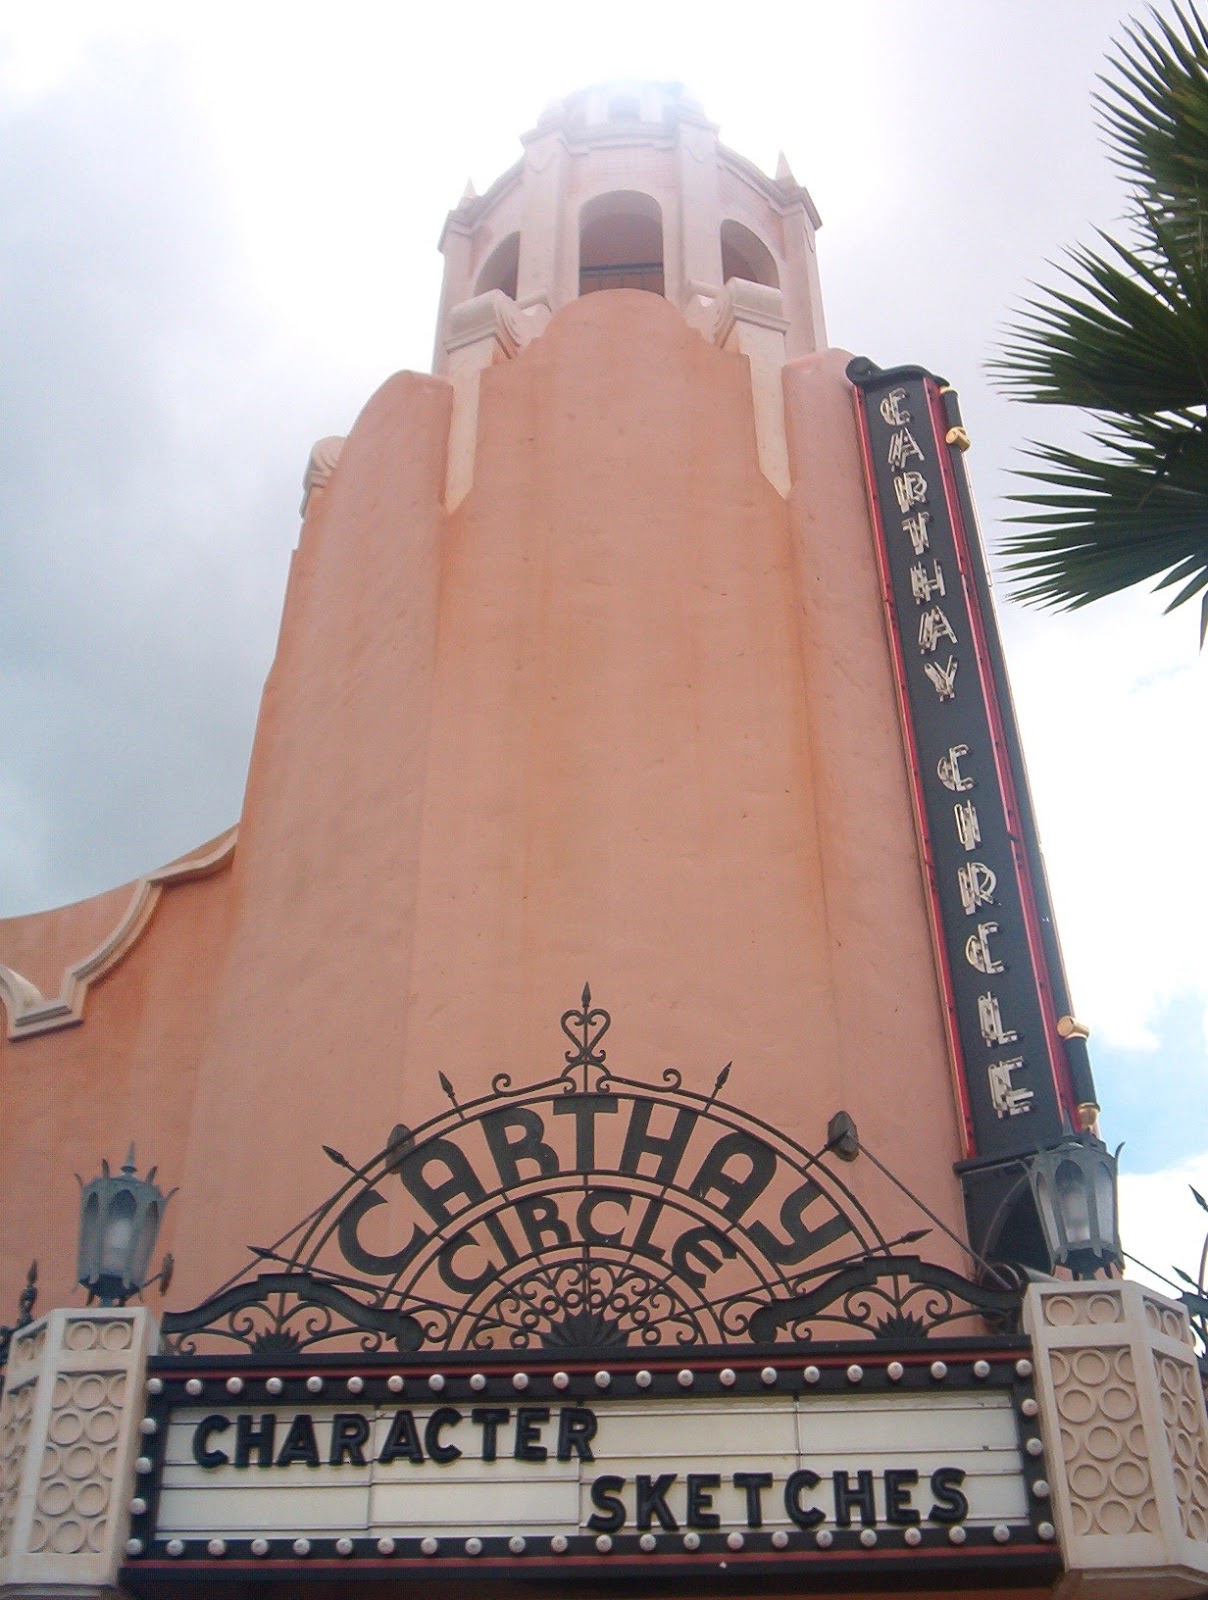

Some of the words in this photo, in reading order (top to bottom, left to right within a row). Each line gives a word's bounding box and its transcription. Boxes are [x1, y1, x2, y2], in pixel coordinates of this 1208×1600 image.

[880, 387, 958, 702] CARTHAY
[937, 744, 1035, 1119] CIRCLE
[337, 1099, 853, 1276] CARTHAY
[438, 1191, 738, 1294] CIRCLE
[193, 1407, 599, 1468] CHARACTER
[586, 1468, 969, 1532] SKETCHES
